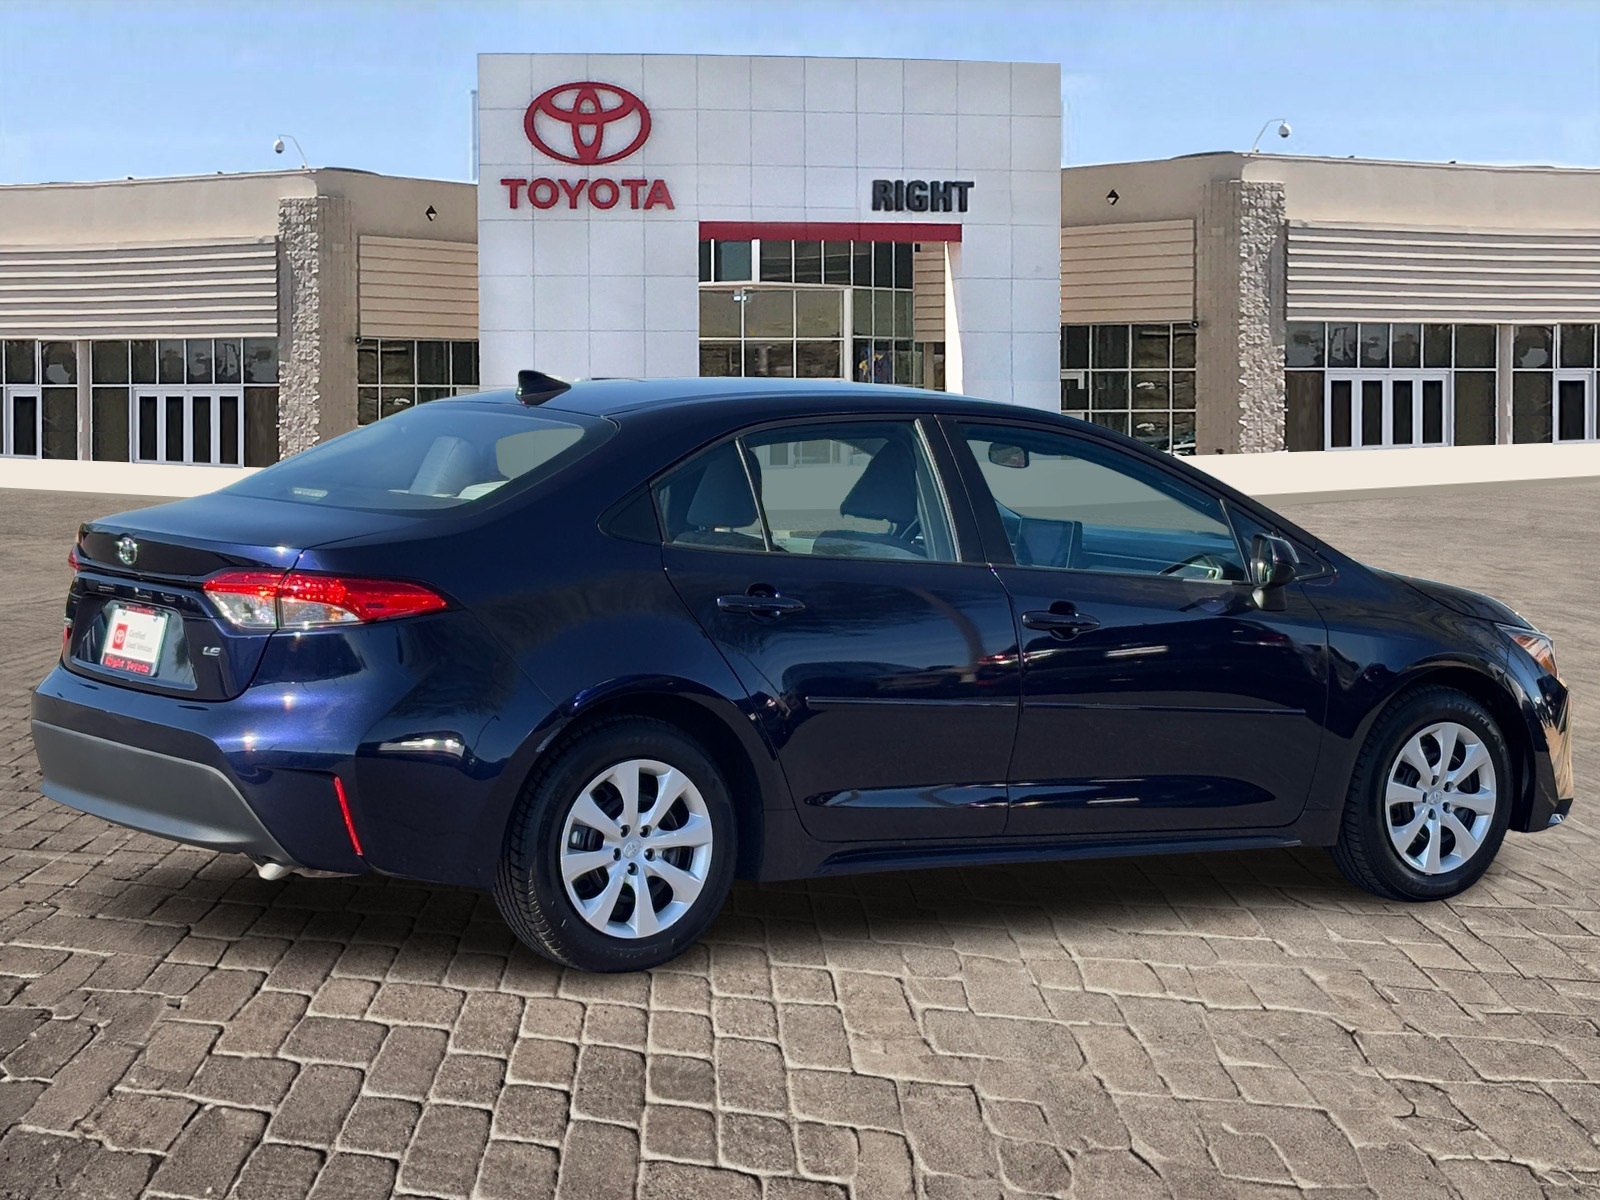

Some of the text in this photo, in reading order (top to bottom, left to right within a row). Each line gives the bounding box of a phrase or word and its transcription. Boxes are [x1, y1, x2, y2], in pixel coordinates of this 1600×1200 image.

[500, 178, 675, 210] TOYOTA
[872, 179, 975, 212] RIGHT
[202, 646, 221, 656] LE
[105, 655, 150, 673] Right Toyota
